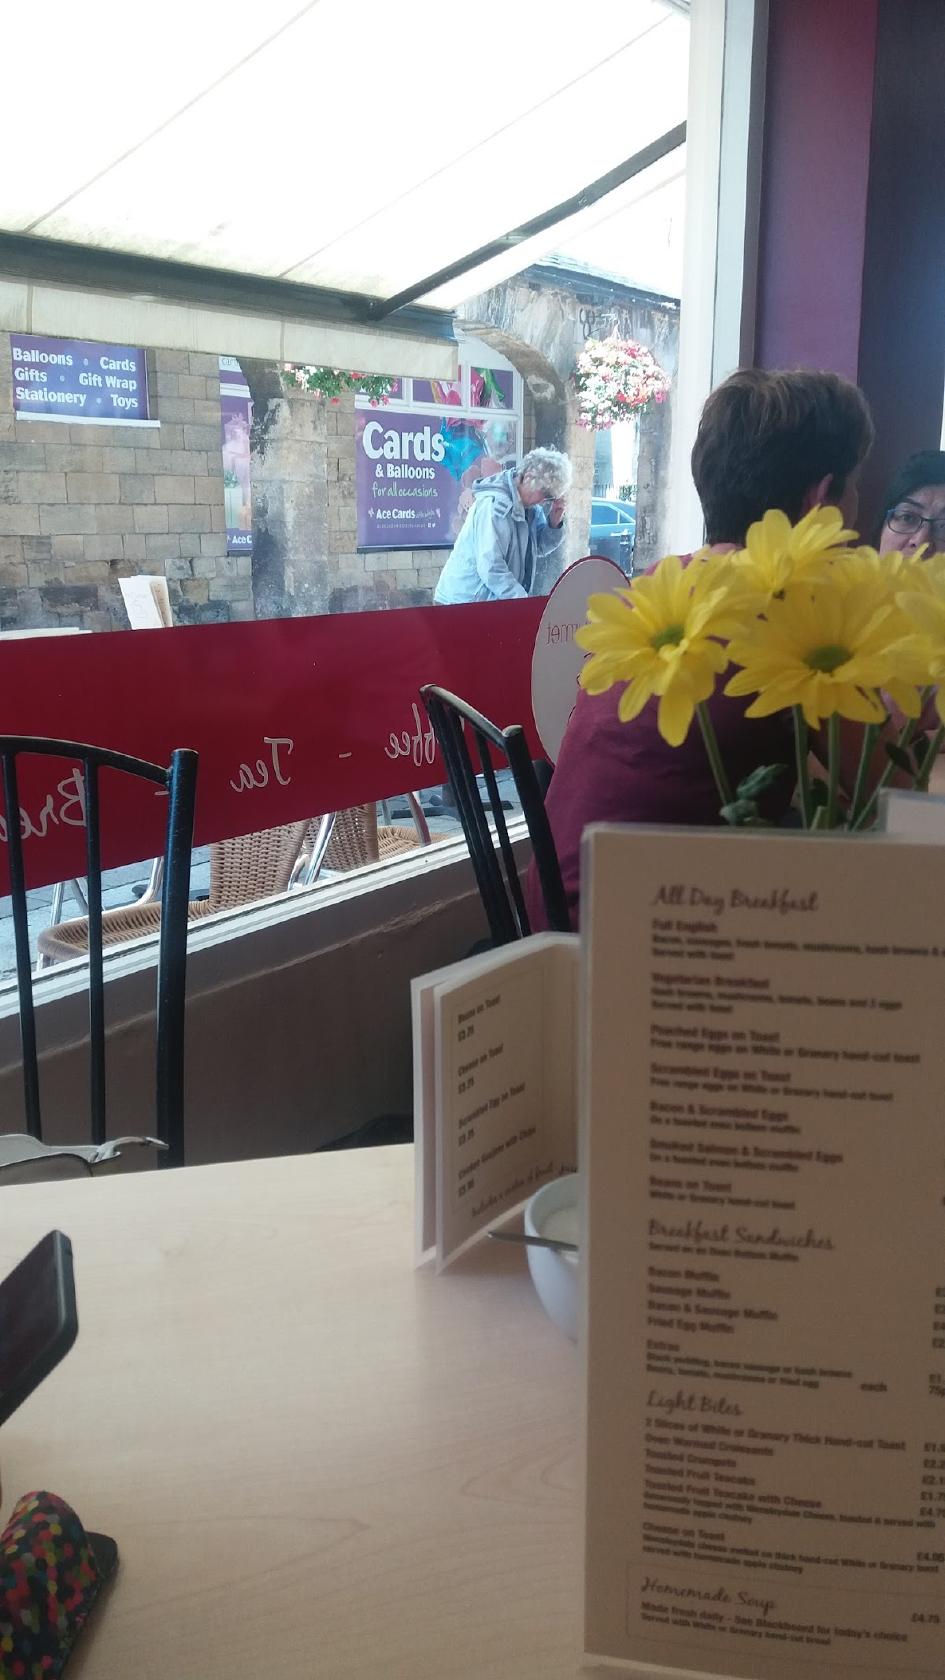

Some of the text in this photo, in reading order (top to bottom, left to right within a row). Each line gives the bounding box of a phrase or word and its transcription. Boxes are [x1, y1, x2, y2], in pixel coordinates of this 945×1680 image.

[13, 348, 136, 372] Balloons Cards
[15, 368, 137, 392] Gifts Gift Wrap
[16, 387, 138, 409] Stationery Toys
[362, 421, 446, 462] Cards
[375, 463, 435, 479] & Balloons
[372, 481, 439, 498] for all occasions
[376, 508, 391, 519] Ace
[392, 508, 416, 519] Cards
[650, 884, 819, 916] All Day Breakfast
[648, 1218, 834, 1250] Breakfast Sandwiches
[646, 1390, 745, 1417] Light Bites
[640, 1576, 778, 1619] Homemade Soup
